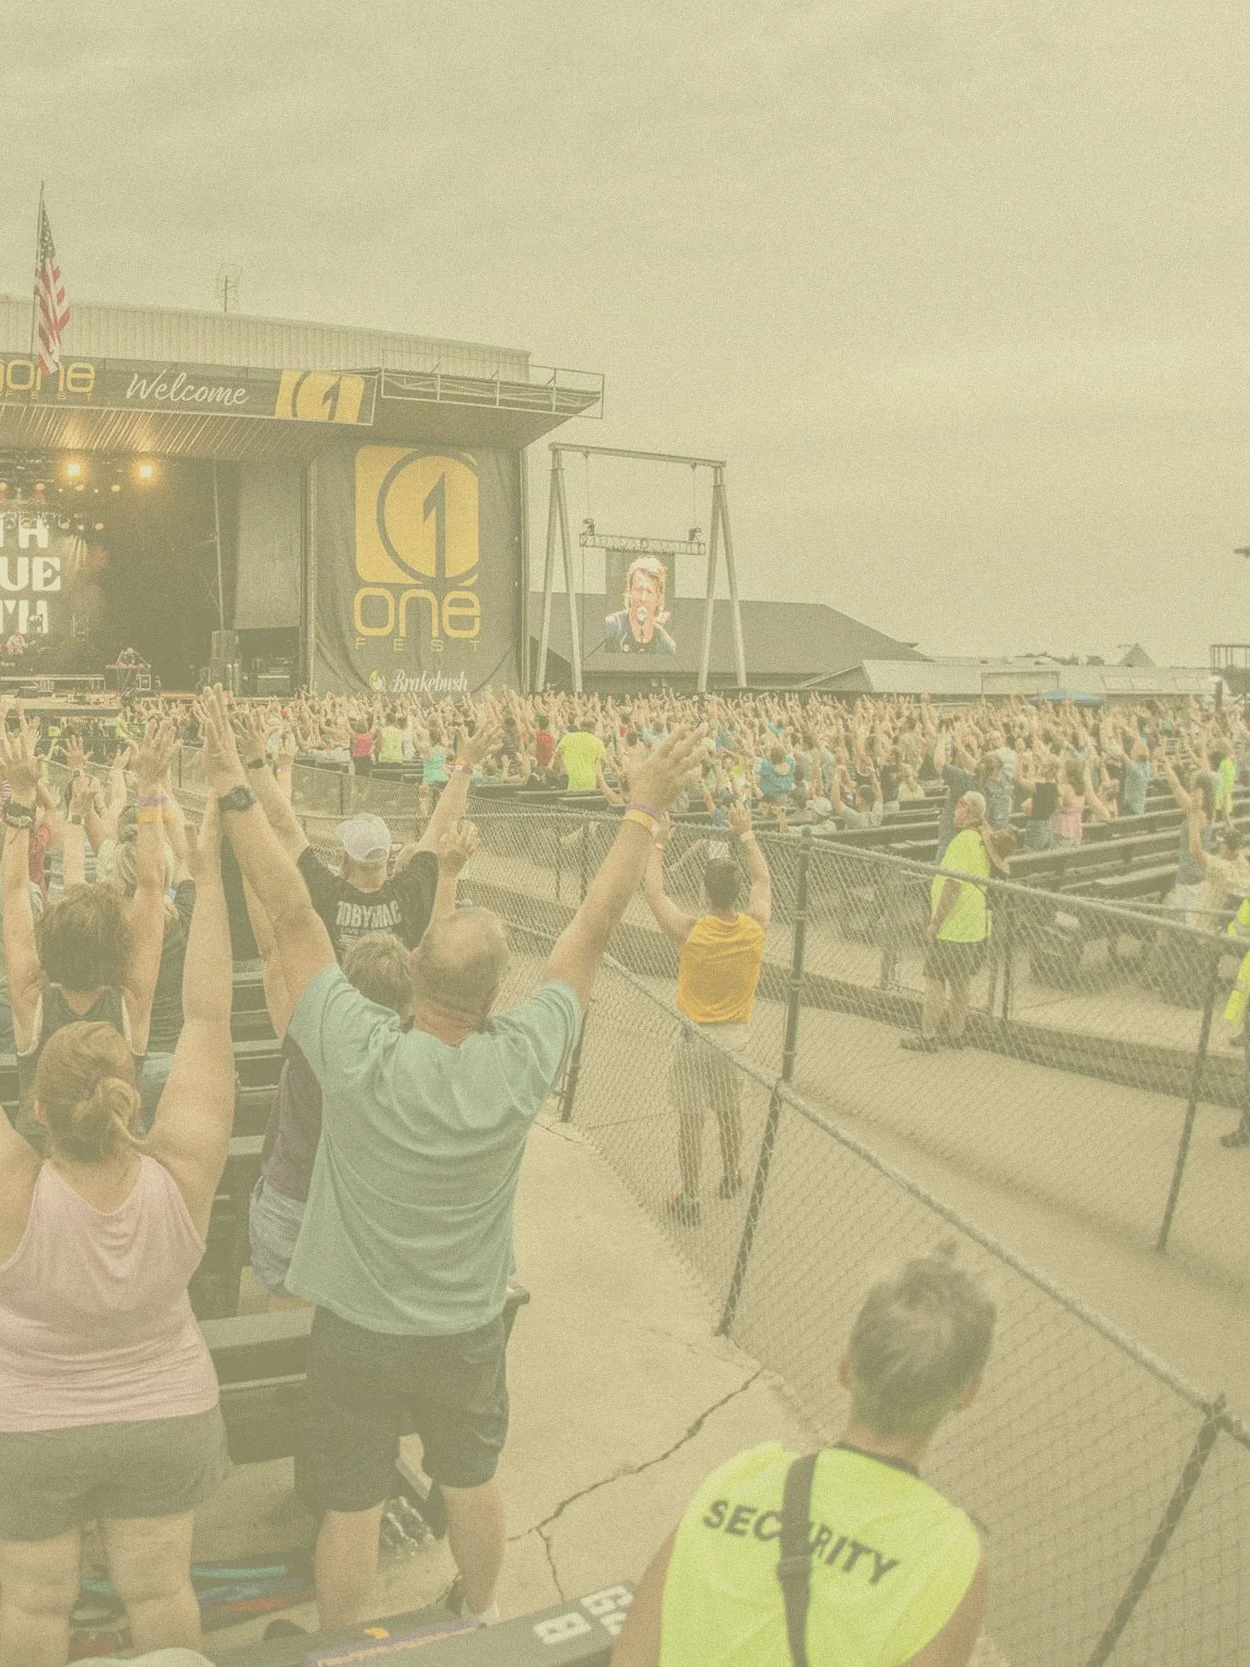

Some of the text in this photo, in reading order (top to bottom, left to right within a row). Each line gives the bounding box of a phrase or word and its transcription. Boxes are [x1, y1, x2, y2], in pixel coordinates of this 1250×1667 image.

[6, 360, 96, 393] one
[126, 367, 250, 406] Welcome
[354, 587, 481, 638] one
[356, 637, 480, 651] FEST
[392, 669, 469, 693] Brakebush
[703, 1499, 900, 1586] SECRITY
